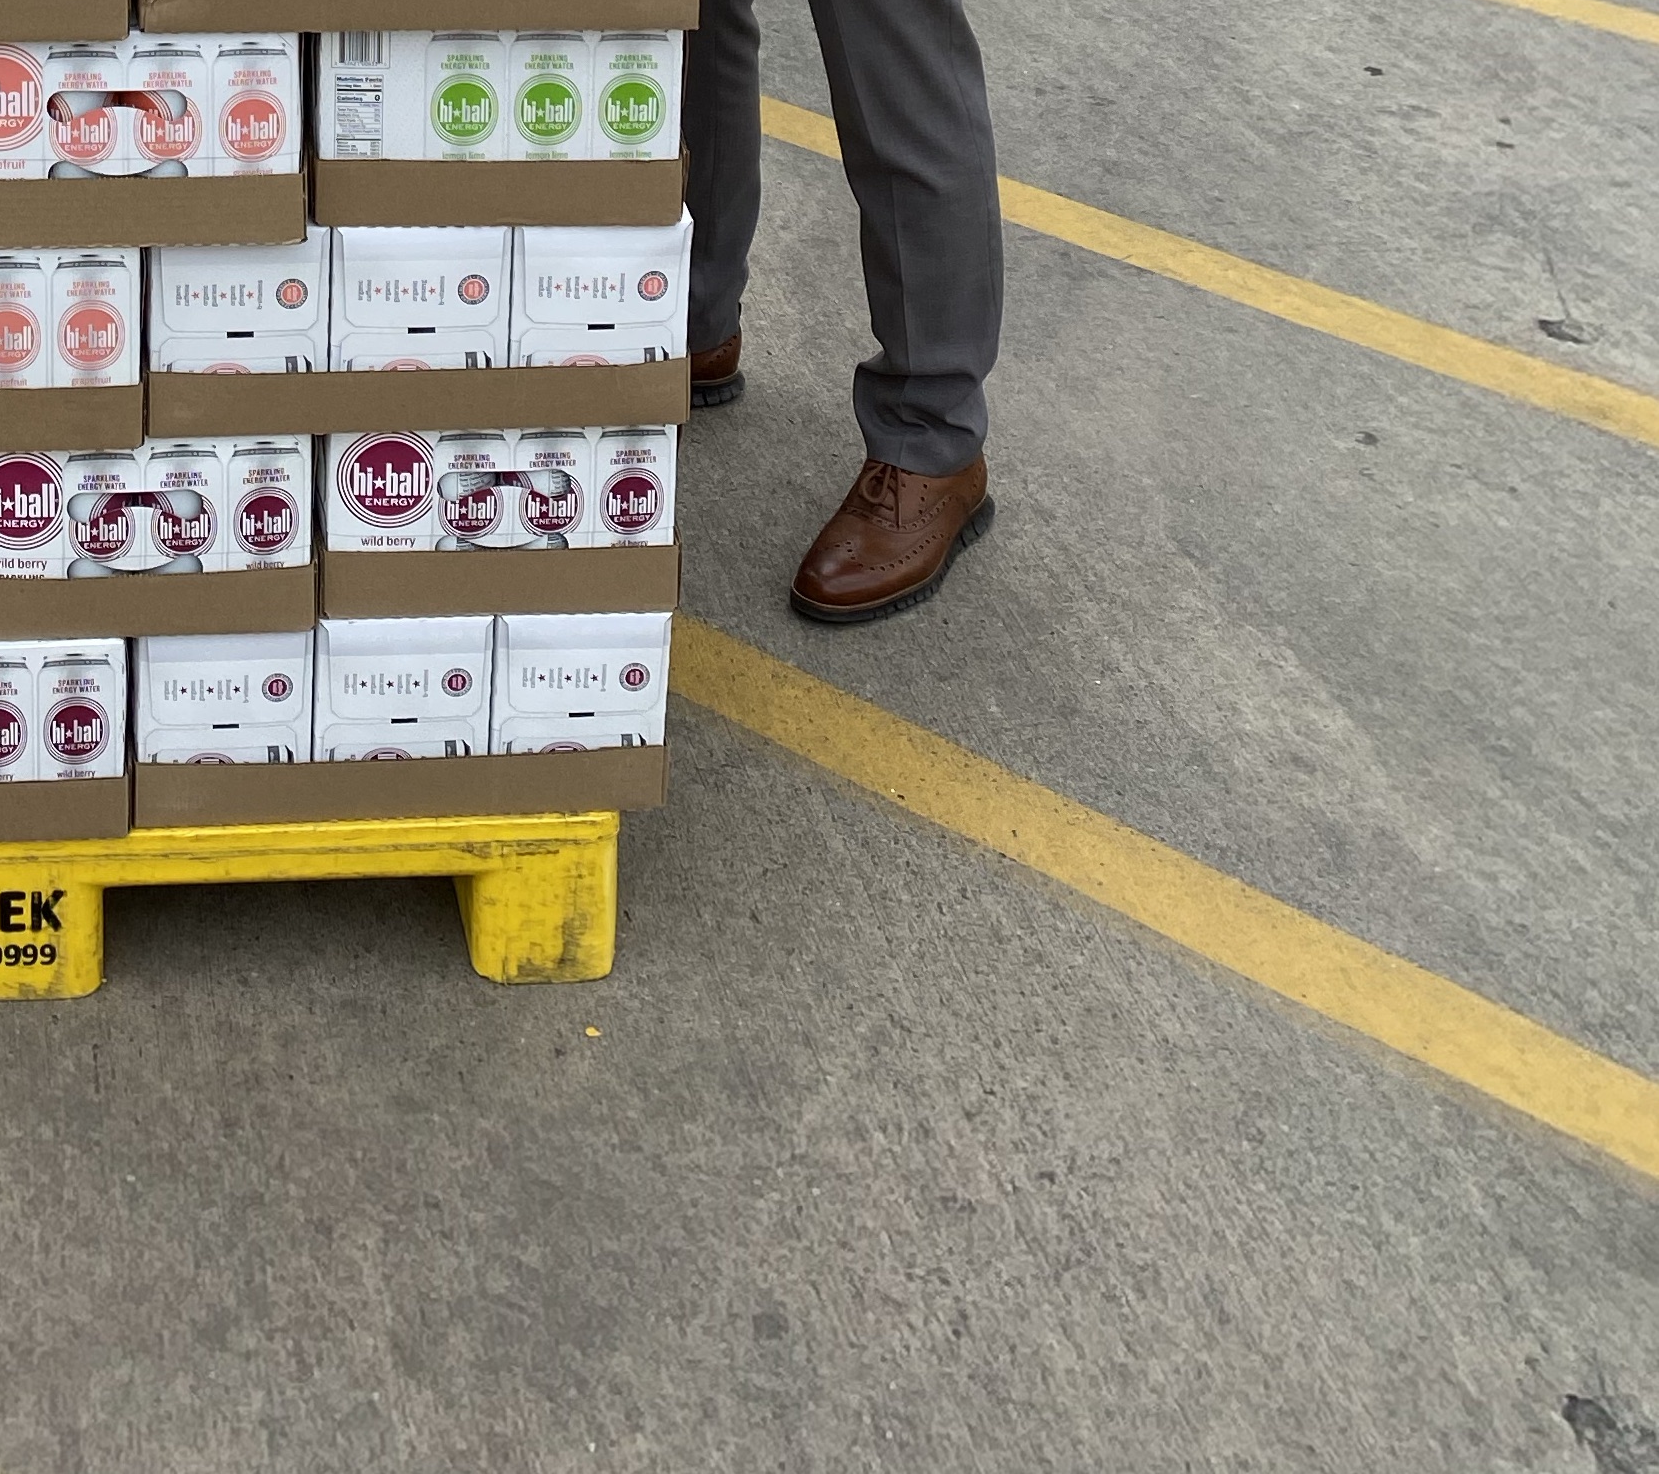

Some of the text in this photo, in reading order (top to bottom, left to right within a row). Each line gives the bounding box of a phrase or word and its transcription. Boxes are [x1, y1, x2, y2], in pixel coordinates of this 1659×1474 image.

[445, 122, 484, 131] ENERGY
[234, 140, 273, 148] ENERGY
[72, 348, 111, 356] ENERGY
[365, 498, 415, 507] ENERGY
[248, 534, 286, 543] ENERGY
[361, 535, 416, 549] wild berry
[18, 558, 48, 571] berry
[58, 742, 96, 751] ENERGY
[56, 770, 96, 779] wild berry
